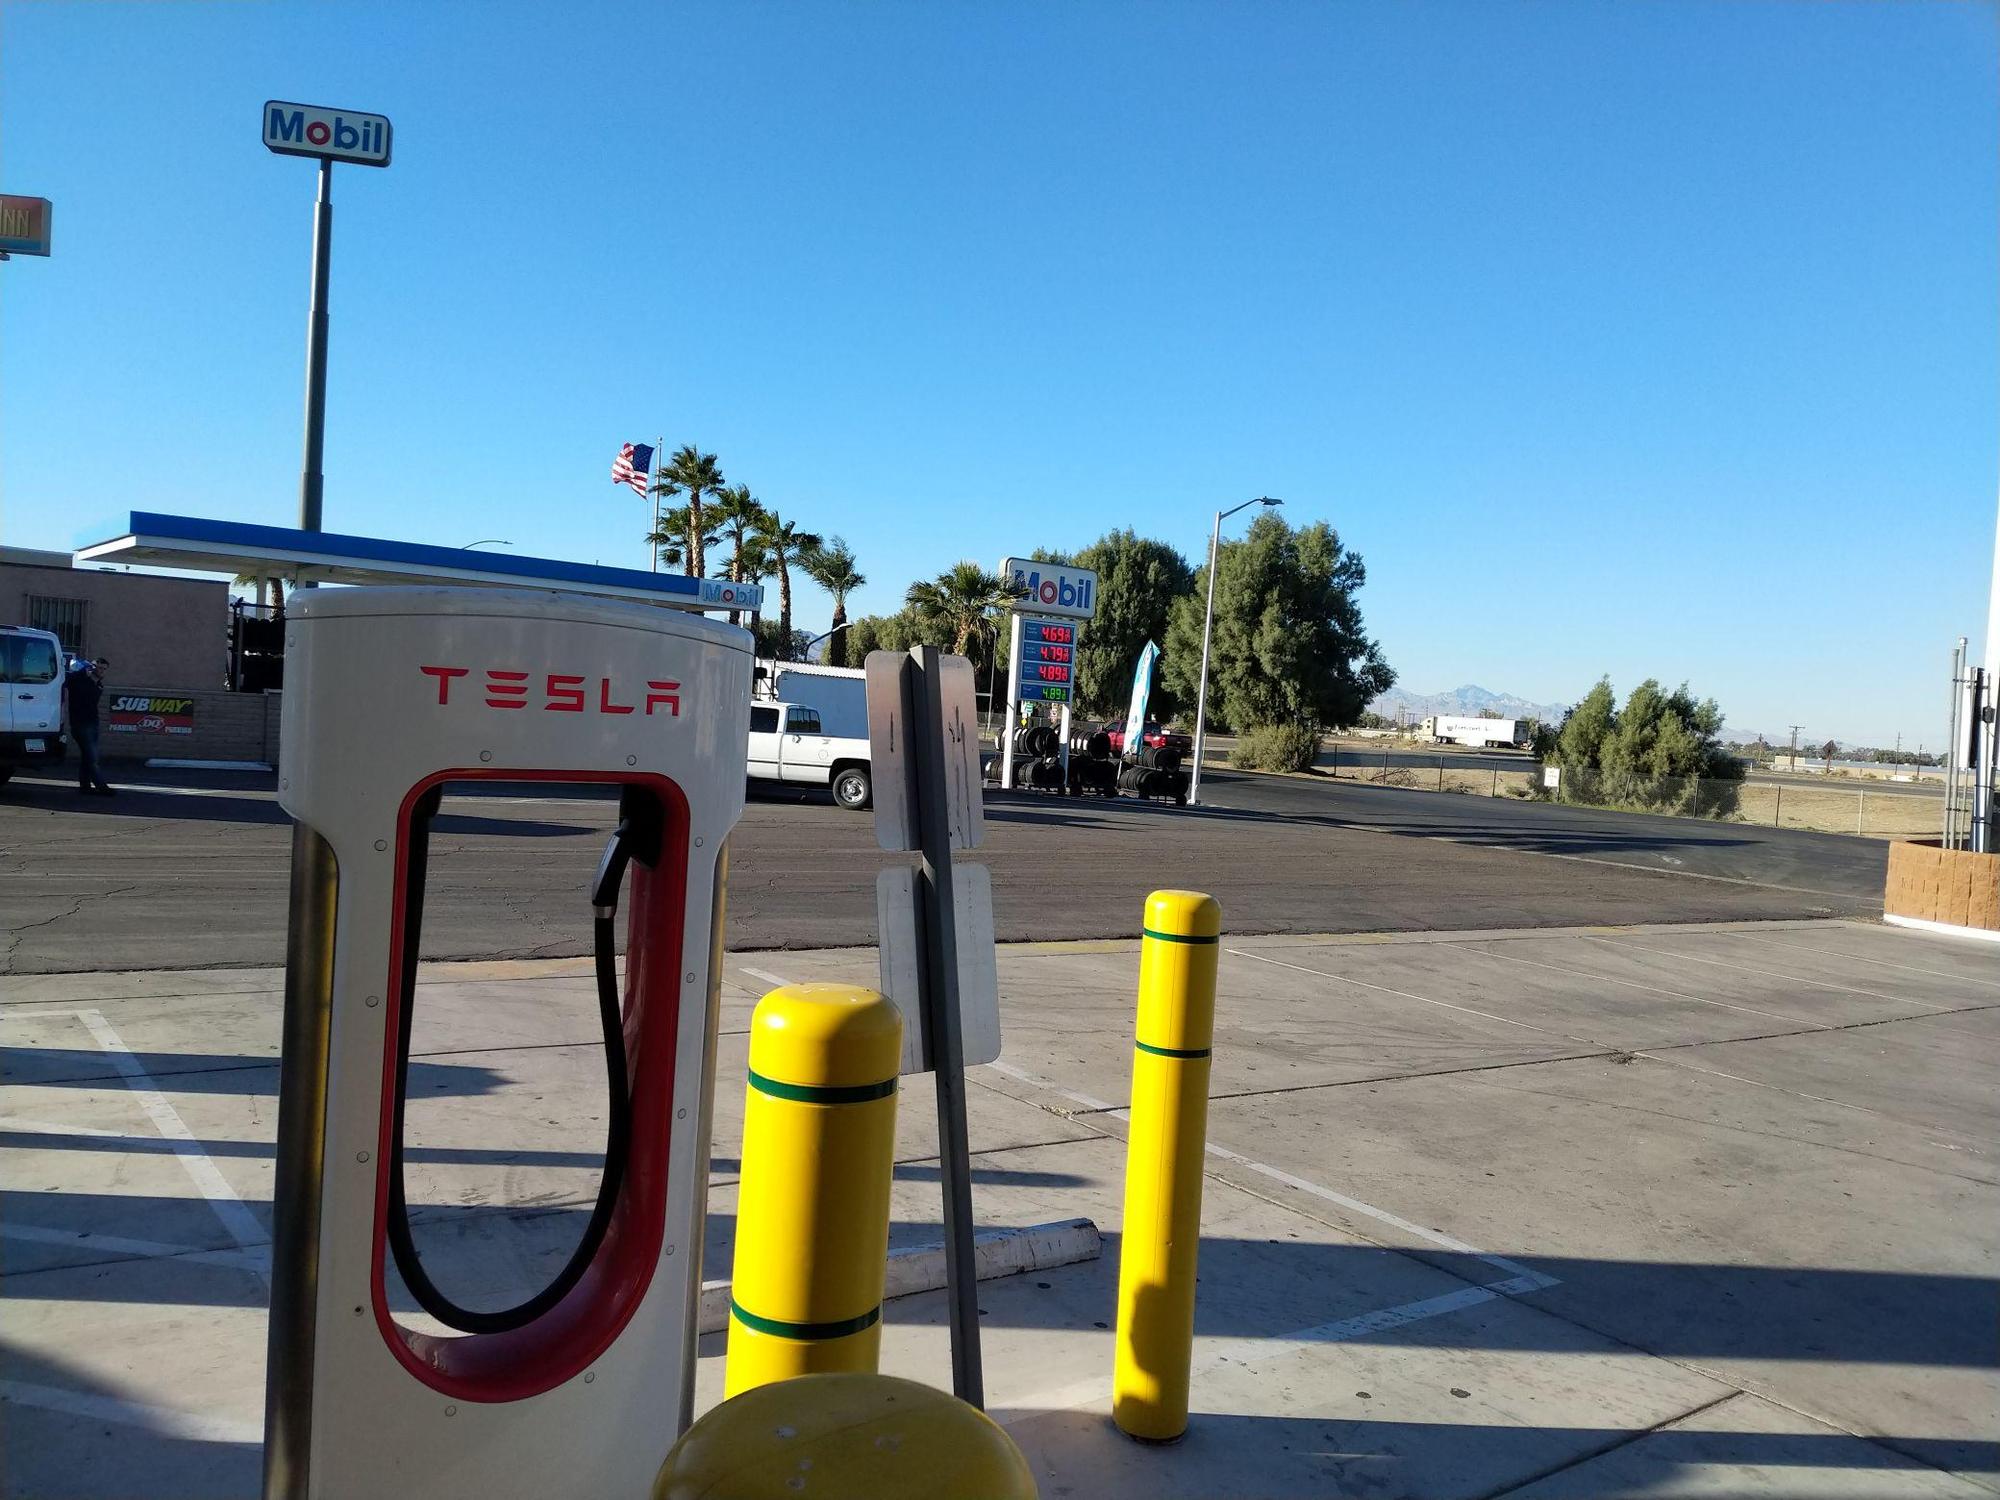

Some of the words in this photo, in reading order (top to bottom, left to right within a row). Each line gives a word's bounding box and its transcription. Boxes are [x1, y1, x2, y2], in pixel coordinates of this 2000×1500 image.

[270, 108, 382, 154] Mobil
[703, 583, 760, 606] Mobil
[1014, 569, 1091, 609] Mobil
[111, 696, 193, 713] SUBWAY
[420, 666, 681, 716] TESLA
